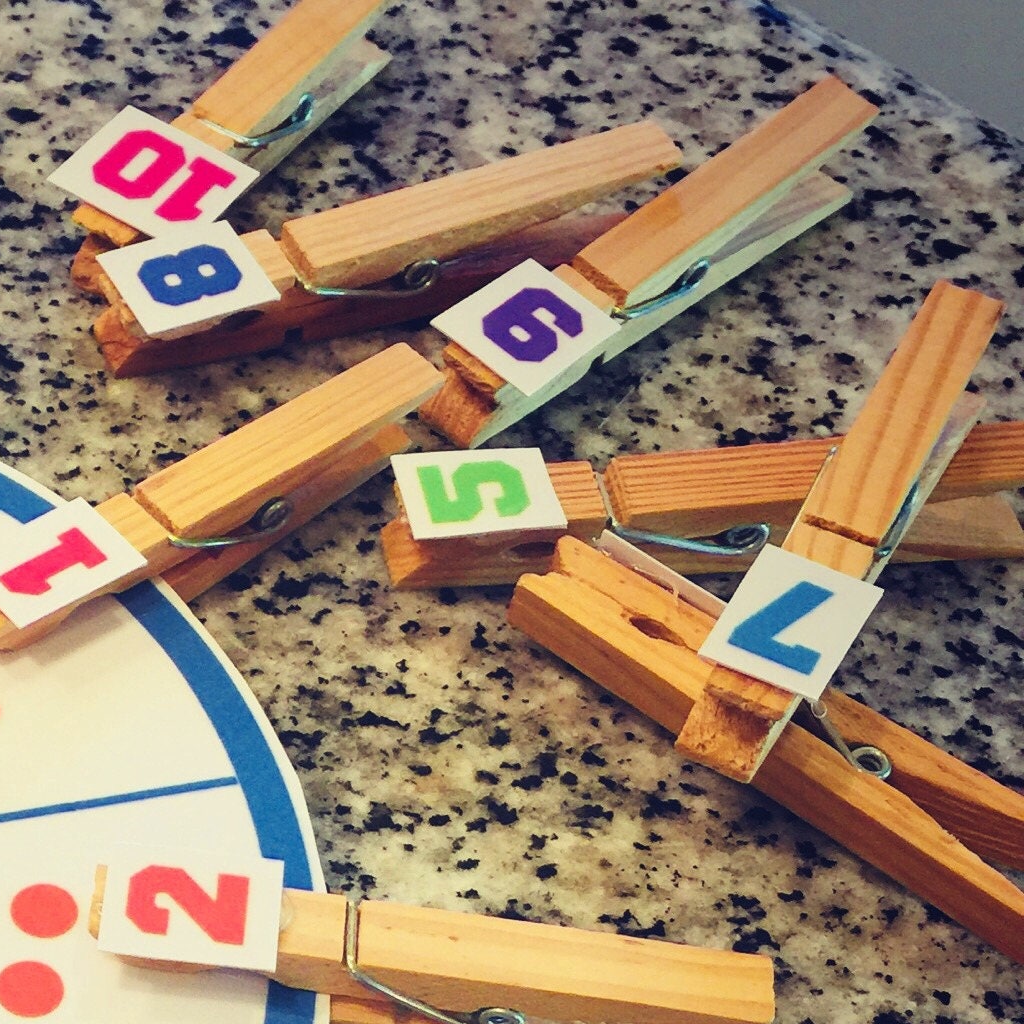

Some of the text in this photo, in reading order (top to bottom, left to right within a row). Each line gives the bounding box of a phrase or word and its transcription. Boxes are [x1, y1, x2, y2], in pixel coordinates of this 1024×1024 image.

[92, 128, 237, 223] 10
[137, 243, 243, 307] 8
[416, 460, 531, 525] 5
[728, 581, 834, 675] 7
[125, 864, 251, 946] 2
